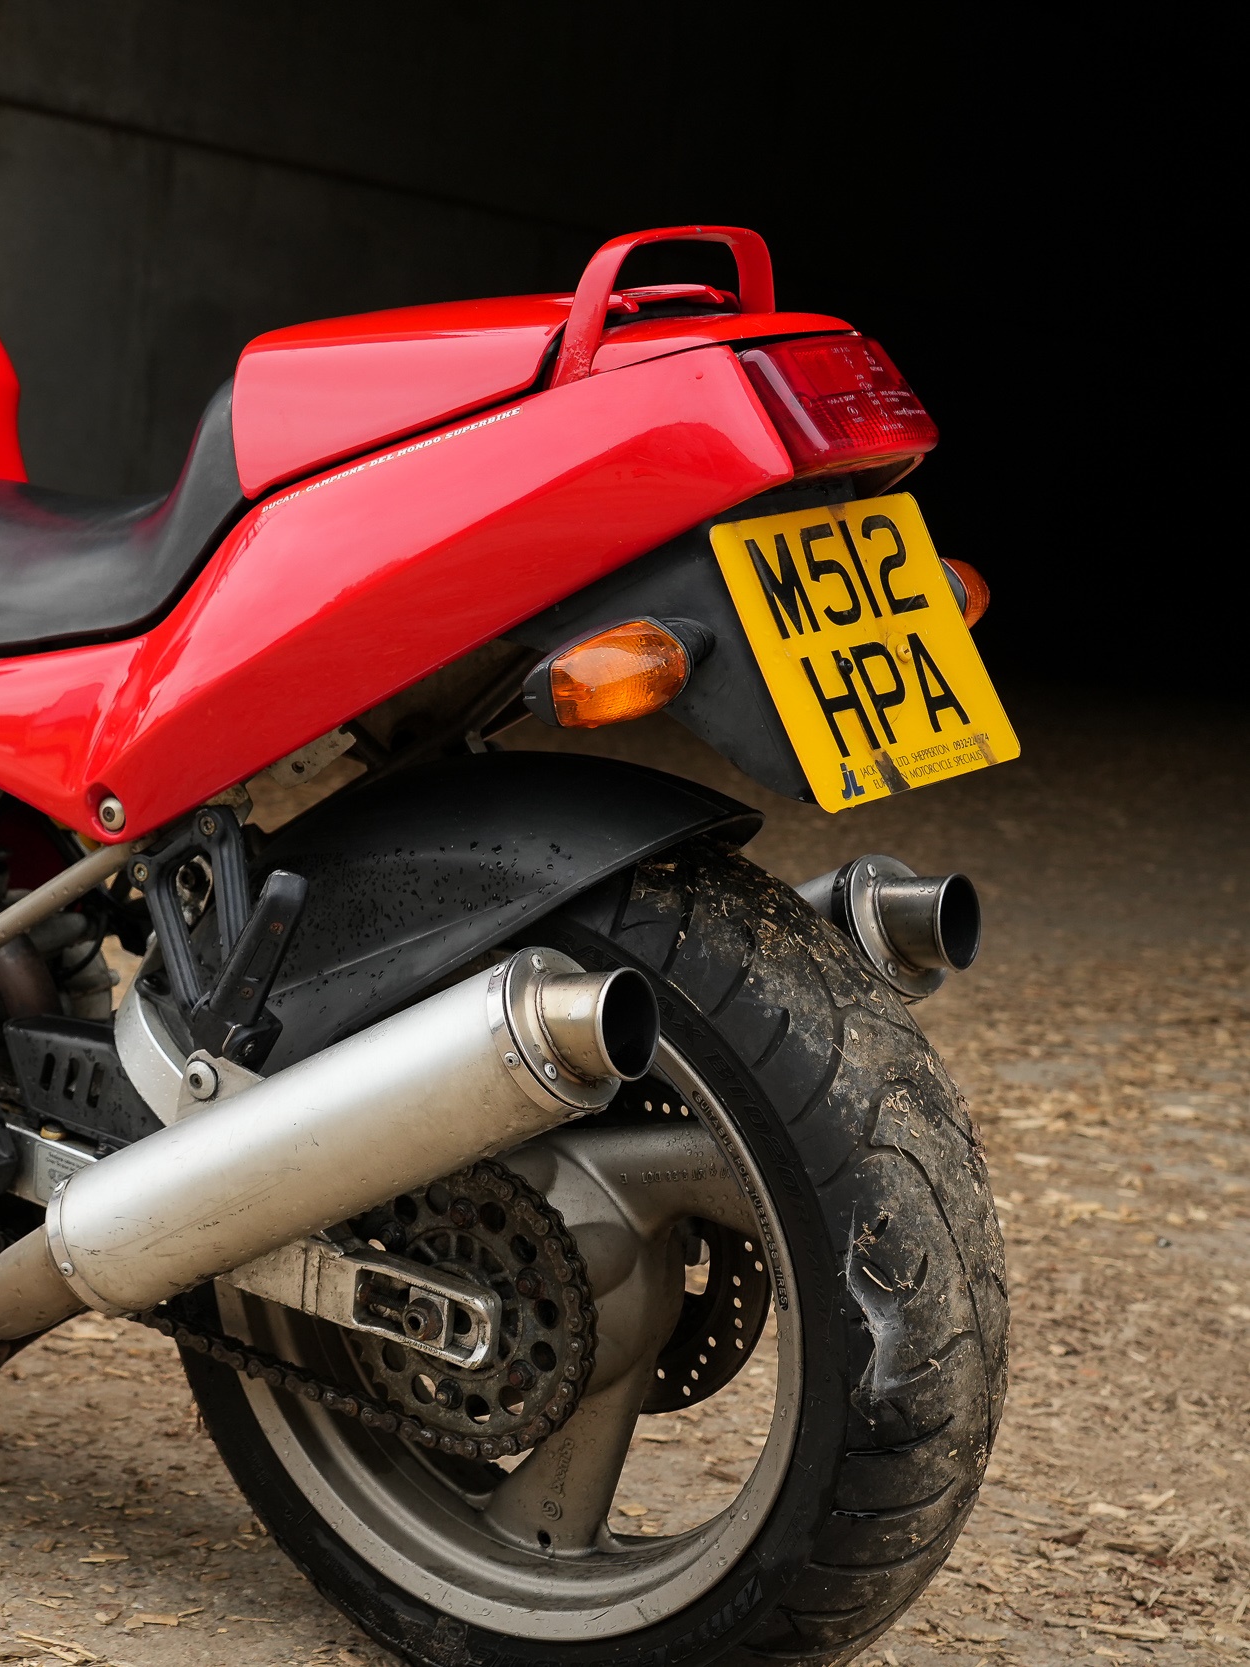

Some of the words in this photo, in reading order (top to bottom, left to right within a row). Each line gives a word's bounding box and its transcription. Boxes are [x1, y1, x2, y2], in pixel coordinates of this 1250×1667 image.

[305, 464, 366, 492] CAMPIONE
[369, 454, 395, 467] DEL
[396, 436, 441, 457] MONDO
[445, 407, 521, 439] SUPERBIKE
[744, 515, 930, 640] M512
[800, 633, 971, 758] HPA
[910, 757, 954, 779] MOTORCYCLE
[911, 744, 951, 764] SHEPPERTON
